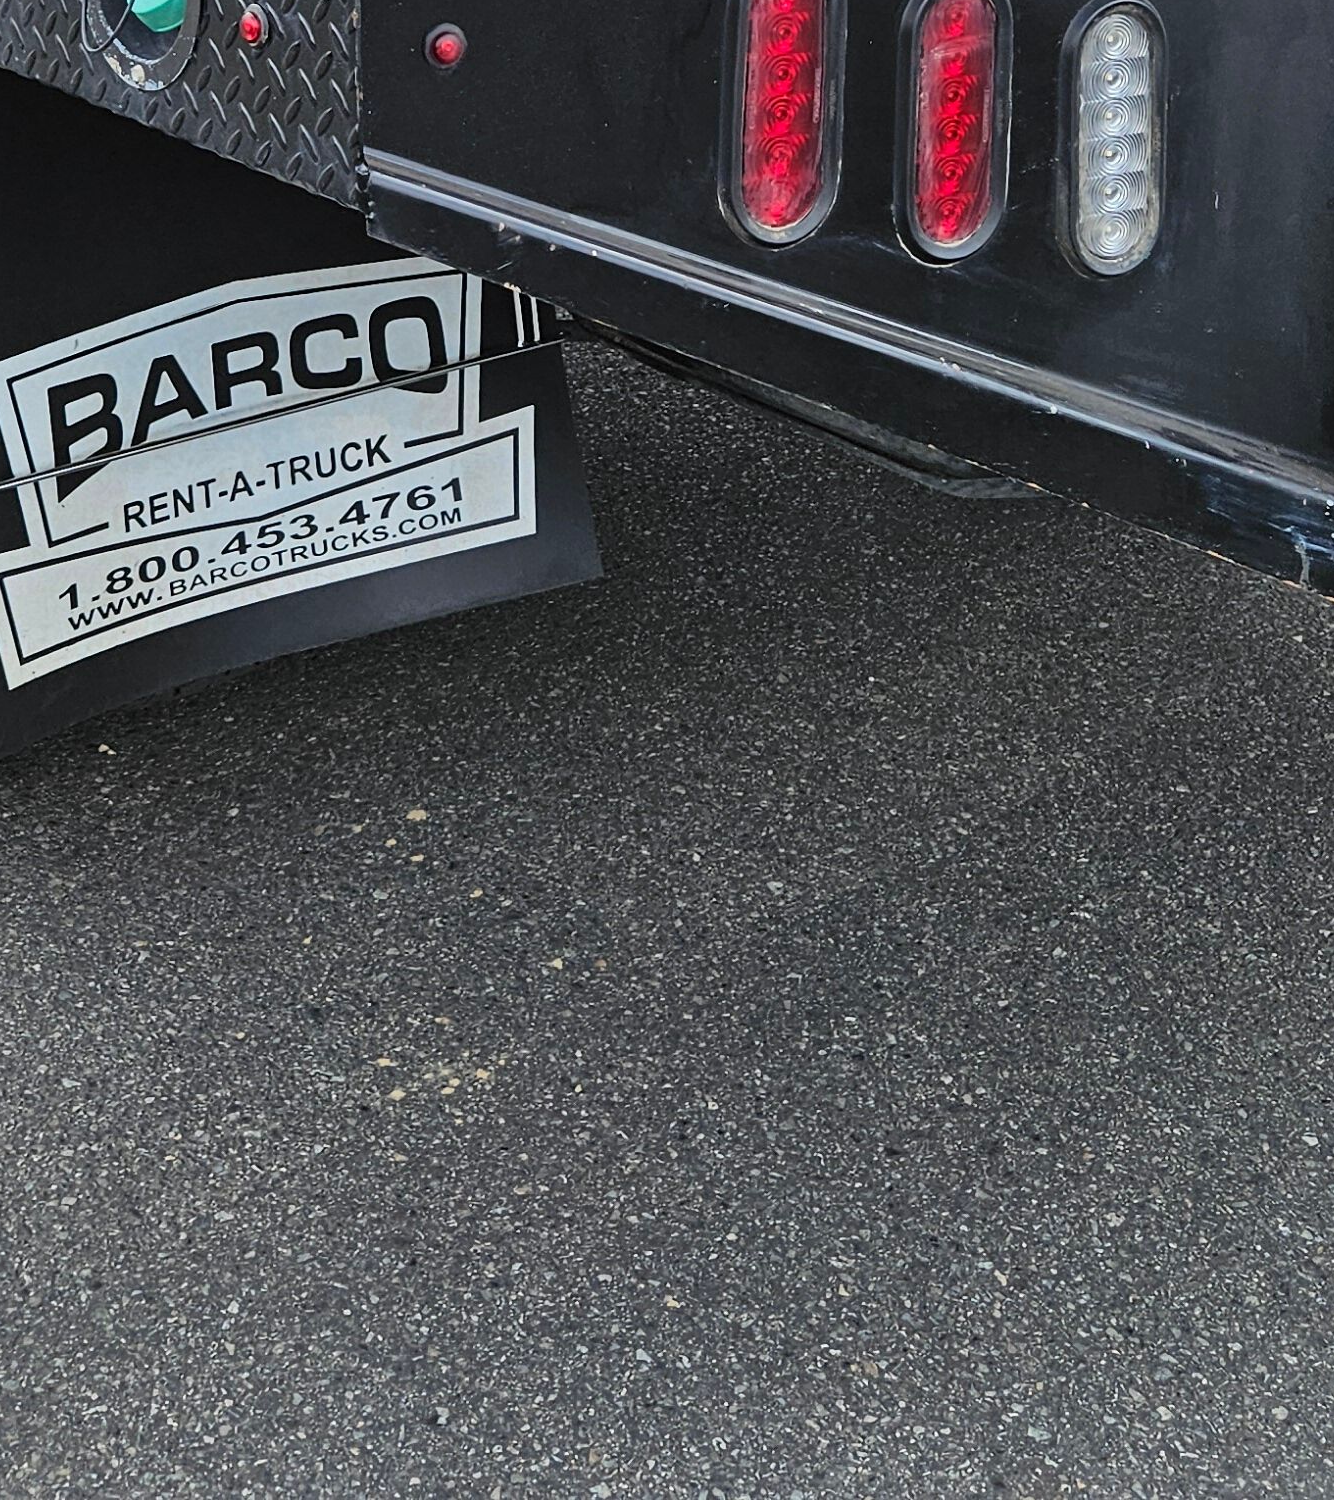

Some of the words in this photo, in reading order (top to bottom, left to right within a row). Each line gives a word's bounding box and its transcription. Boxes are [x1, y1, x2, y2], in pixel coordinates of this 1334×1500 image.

[46, 296, 449, 503] BARCO
[57, 477, 465, 610] 1.800.453.4761
[122, 434, 393, 533] RENT-A-TRUCK
